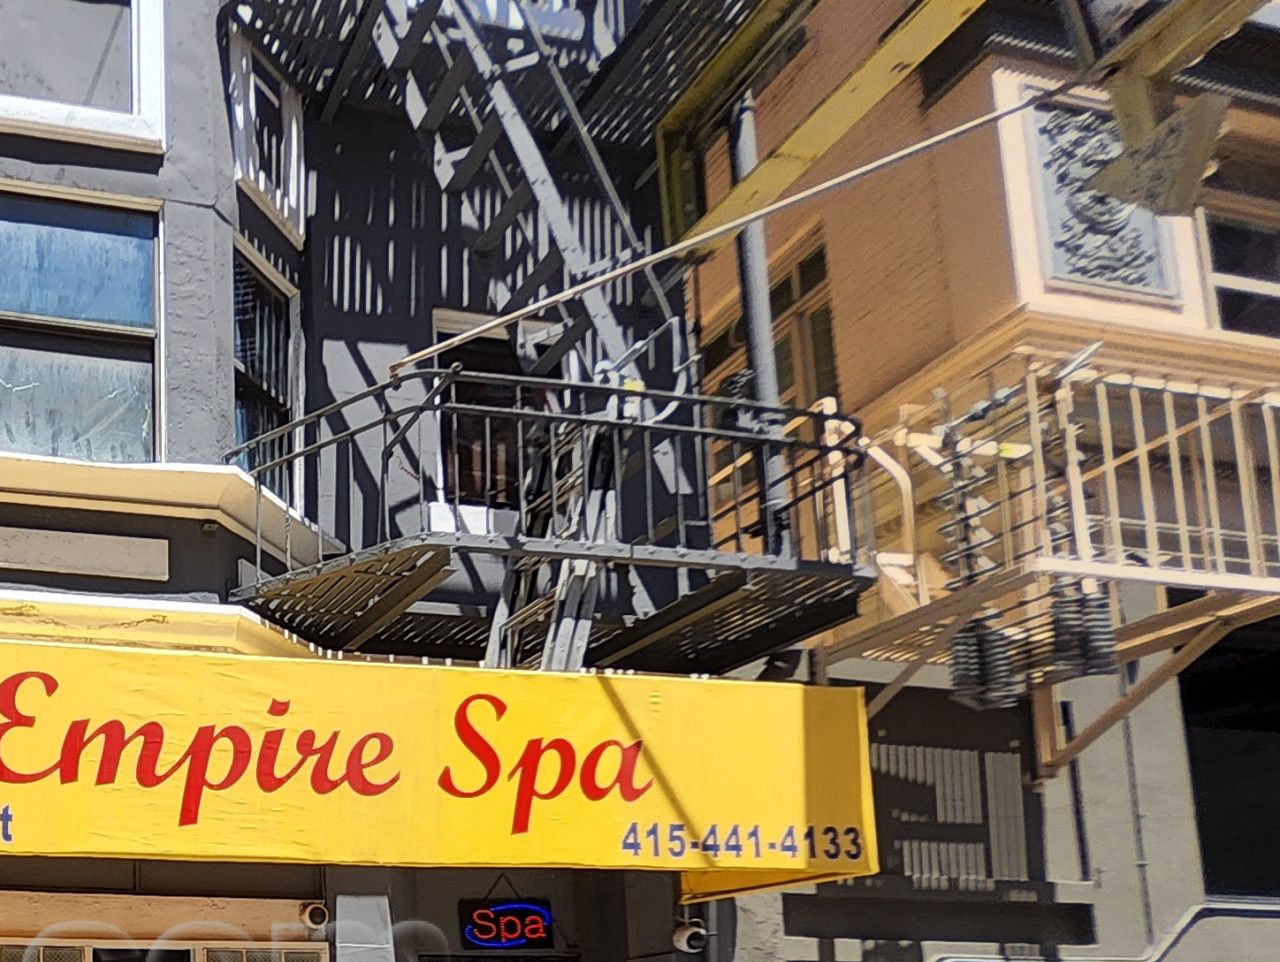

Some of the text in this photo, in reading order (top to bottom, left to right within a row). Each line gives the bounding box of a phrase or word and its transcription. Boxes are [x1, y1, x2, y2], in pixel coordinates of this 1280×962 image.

[438, 692, 654, 835] Spa
[622, 821, 862, 861] 415-441-4133
[472, 908, 547, 943] Spa
